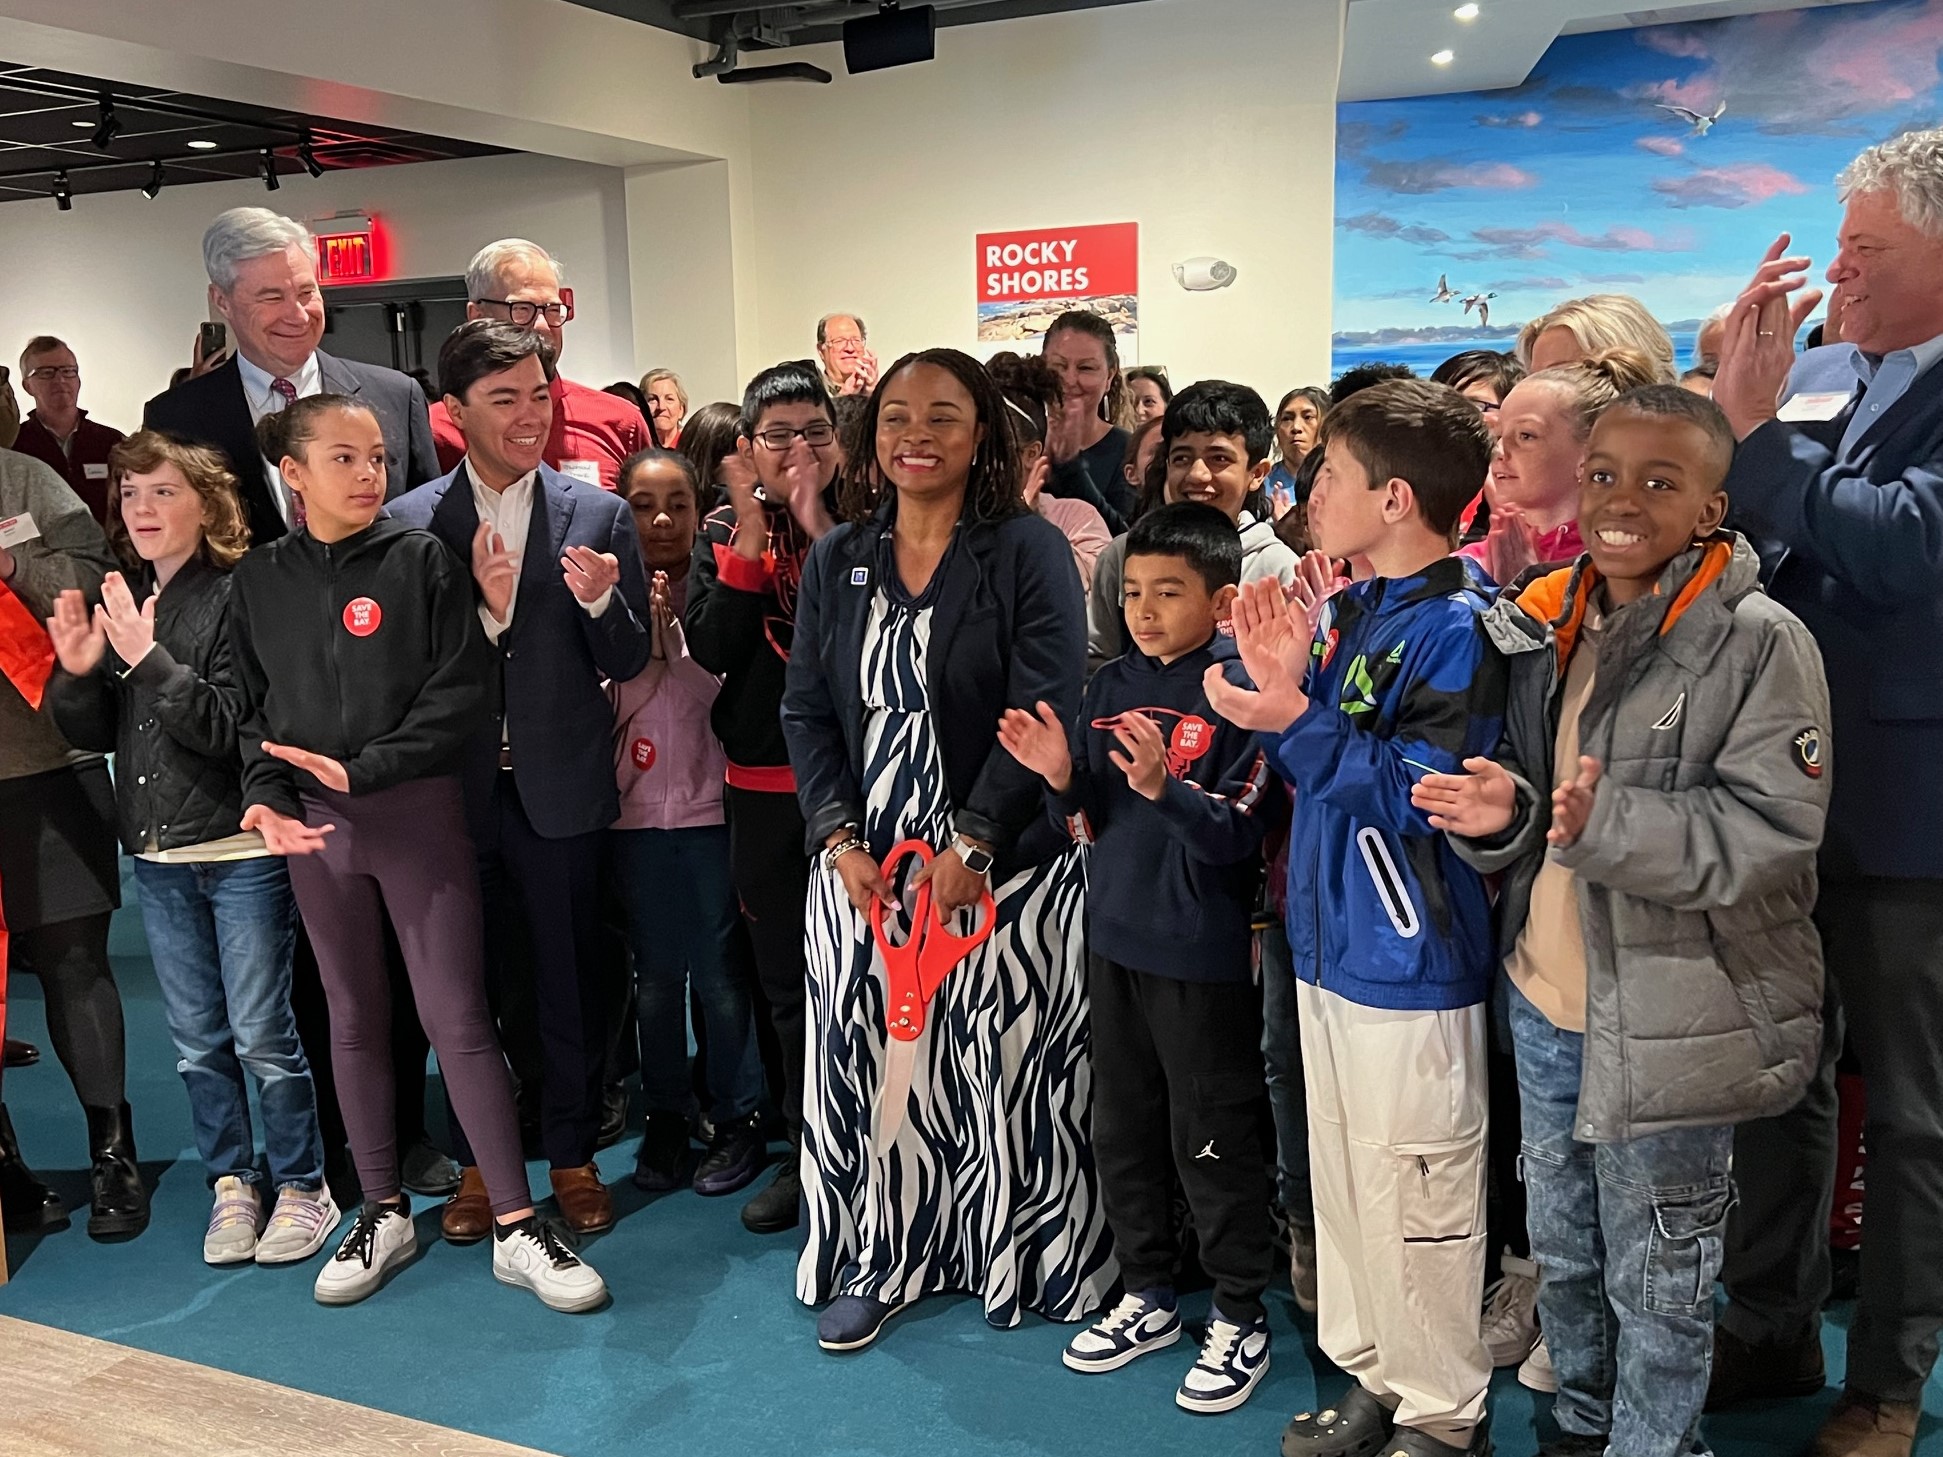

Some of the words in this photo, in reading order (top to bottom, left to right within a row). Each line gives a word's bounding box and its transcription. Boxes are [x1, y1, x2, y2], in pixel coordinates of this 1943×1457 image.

[326, 236, 365, 277] EXIT
[986, 239, 1078, 267] ROCKY
[986, 267, 1089, 296] SHORES
[352, 603, 372, 612] SAVE
[354, 611, 369, 619] THE
[1216, 619, 1232, 628] SAV
[1182, 722, 1203, 732] SAVE
[1183, 730, 1198, 740] THE
